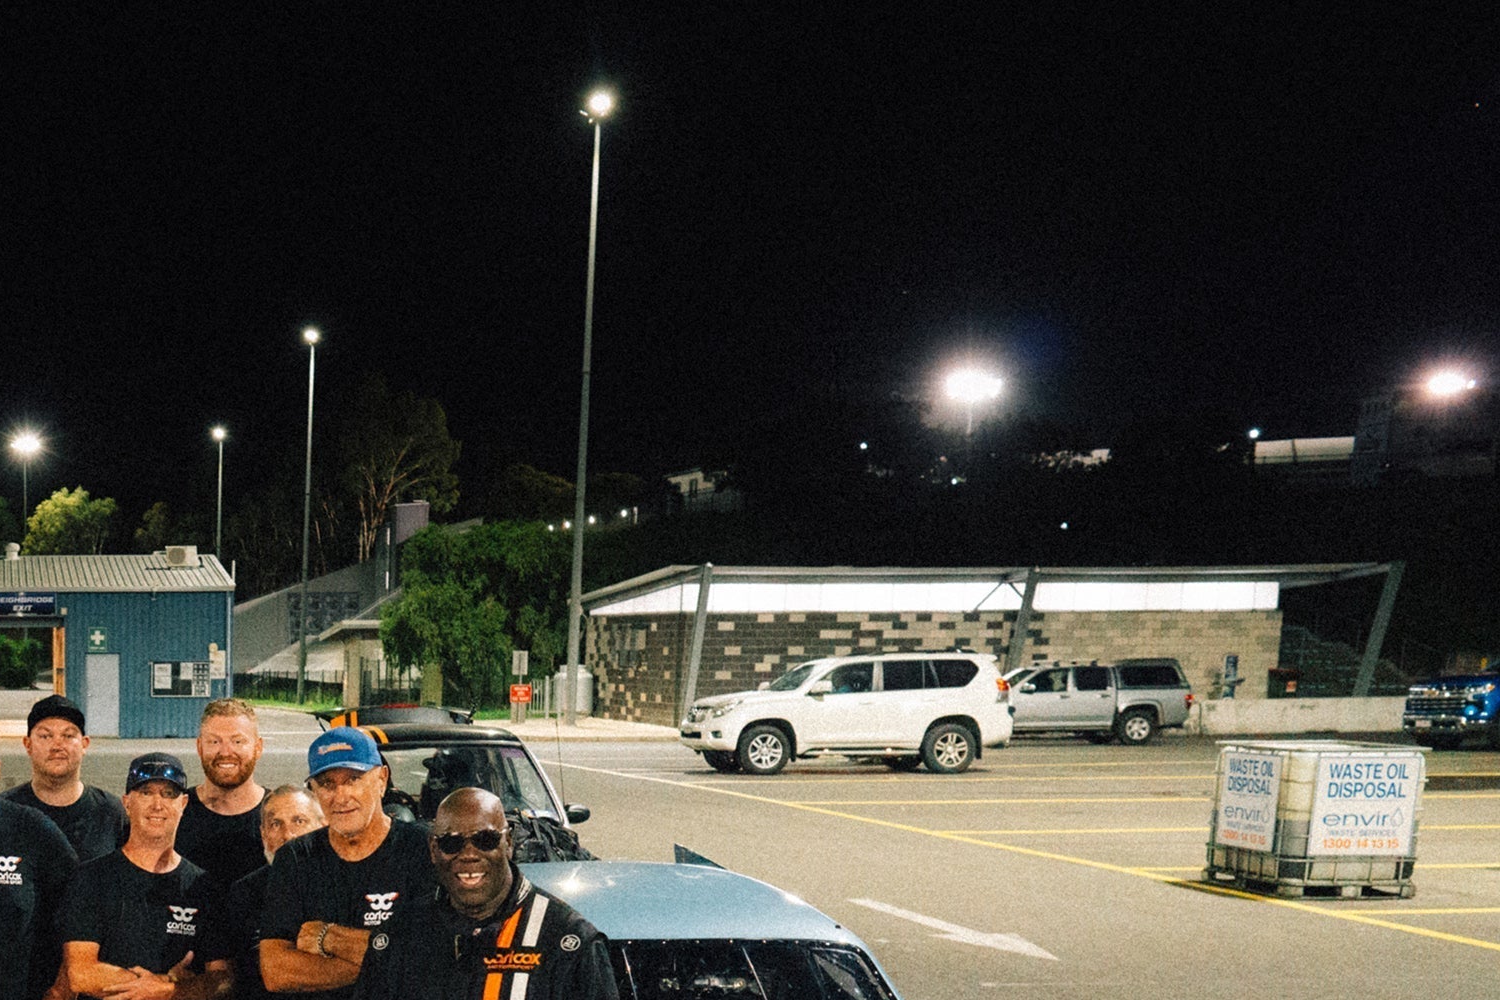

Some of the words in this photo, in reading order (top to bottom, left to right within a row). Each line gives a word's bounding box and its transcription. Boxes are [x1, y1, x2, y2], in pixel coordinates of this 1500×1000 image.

[1229, 758, 1260, 776] WASTE
[1261, 760, 1274, 778] OIL
[1329, 763, 1384, 779] WASTE
[1386, 763, 1409, 779] OIL
[1228, 775, 1272, 795] DISPOSAL
[1327, 781, 1407, 798] DISPOSAL
[1323, 838, 1352, 849] 1300
[1357, 838, 1369, 849] 14
[1372, 838, 1384, 849] 13
[1387, 838, 1400, 849] 15
